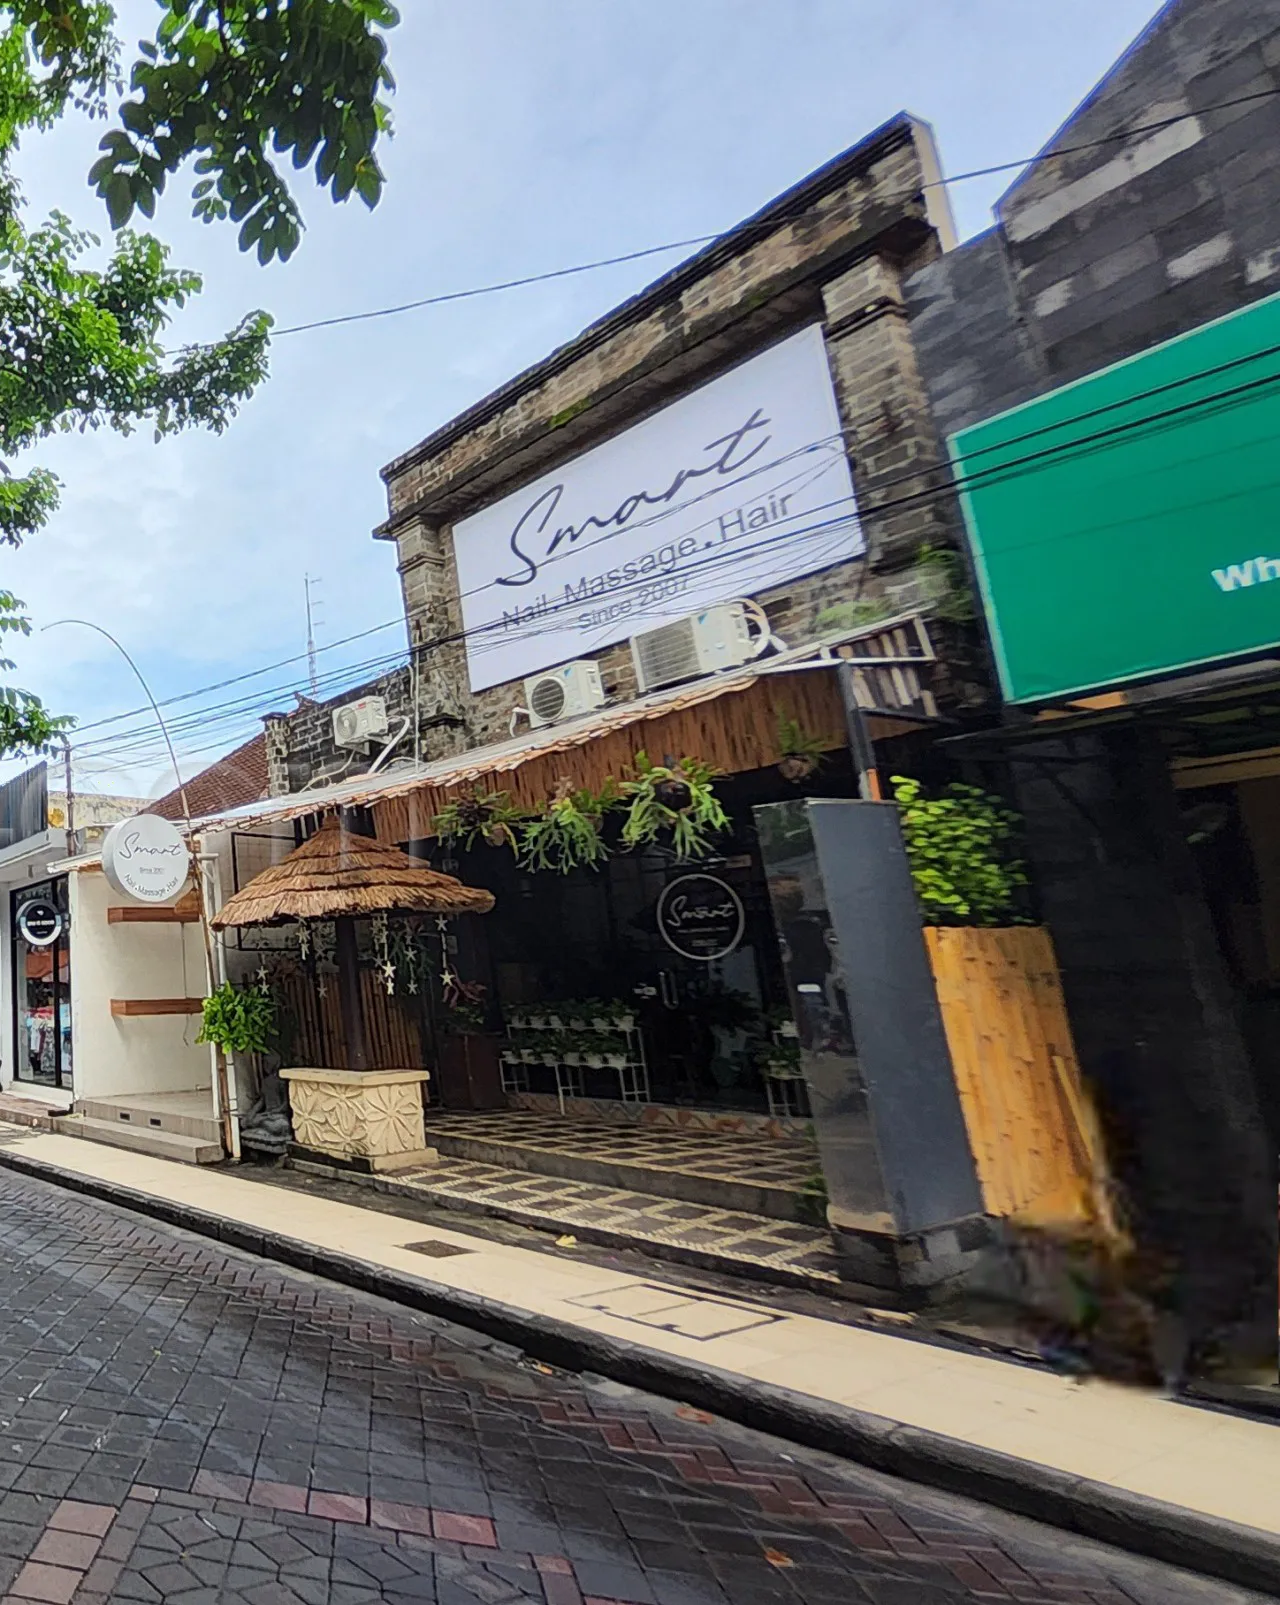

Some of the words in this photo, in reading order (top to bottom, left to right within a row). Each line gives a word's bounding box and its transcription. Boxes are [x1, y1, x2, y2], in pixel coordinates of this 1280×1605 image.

[495, 408, 771, 586] Smart
[719, 494, 793, 541] Hair
[119, 831, 181, 859] Smart
[665, 894, 736, 927] Smart
